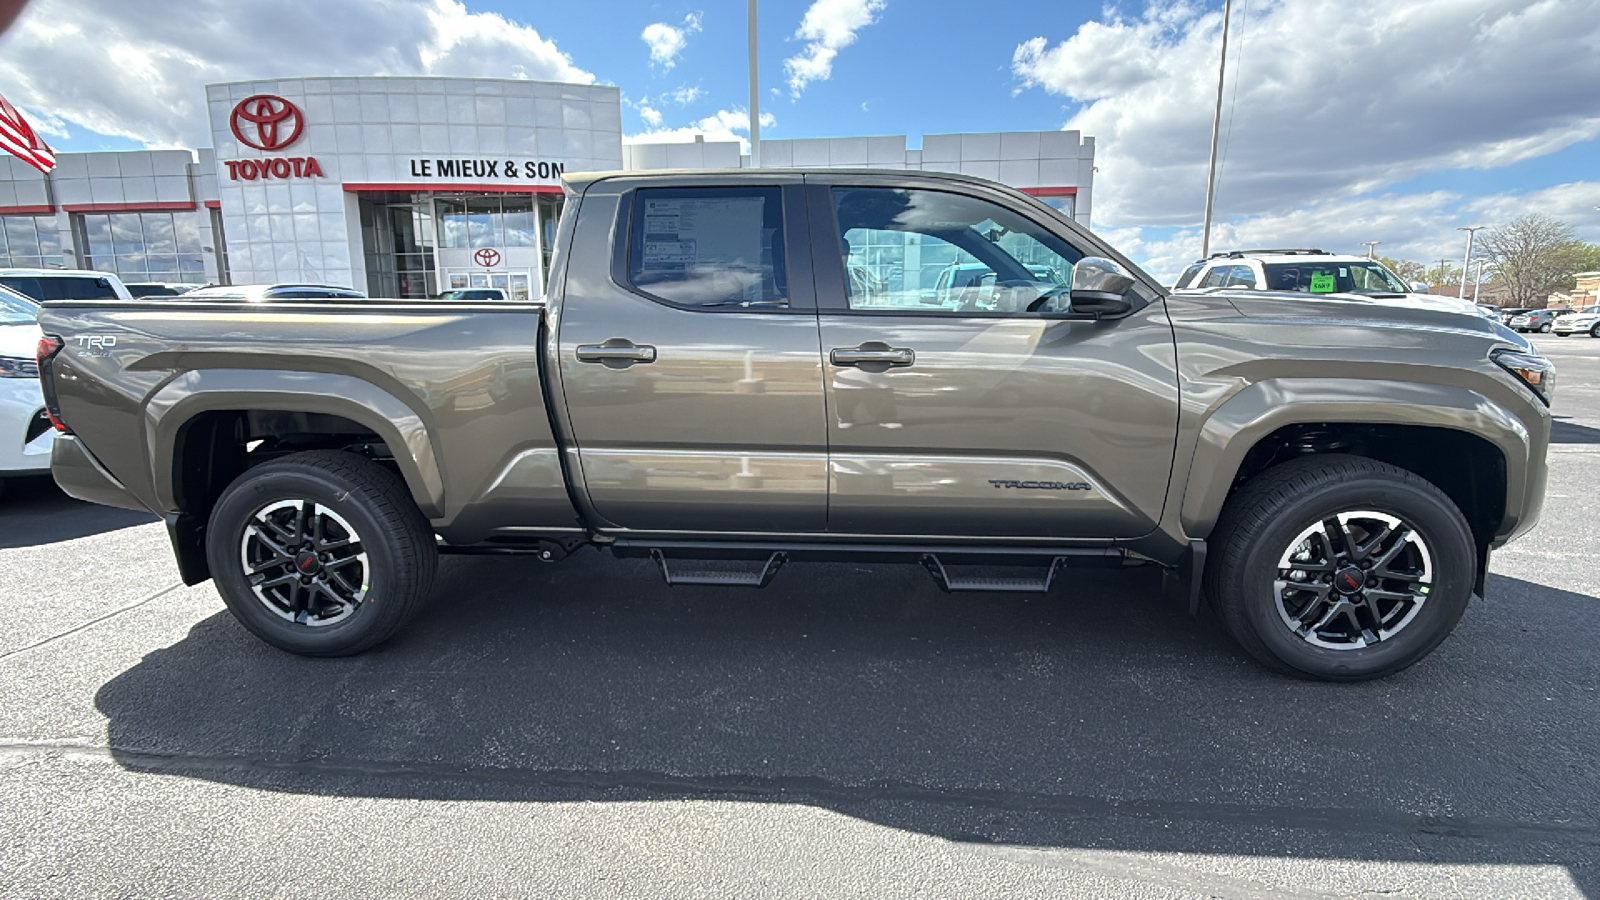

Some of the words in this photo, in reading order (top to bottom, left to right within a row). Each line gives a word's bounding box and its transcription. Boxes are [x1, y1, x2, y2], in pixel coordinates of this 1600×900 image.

[224, 157, 323, 180] TOYOTA
[411, 160, 431, 177] LE
[437, 160, 498, 178] MIEUX
[504, 161, 519, 178] &
[525, 162, 564, 179] SON
[74, 335, 117, 350] TRD
[988, 479, 1092, 491] TACOMA
